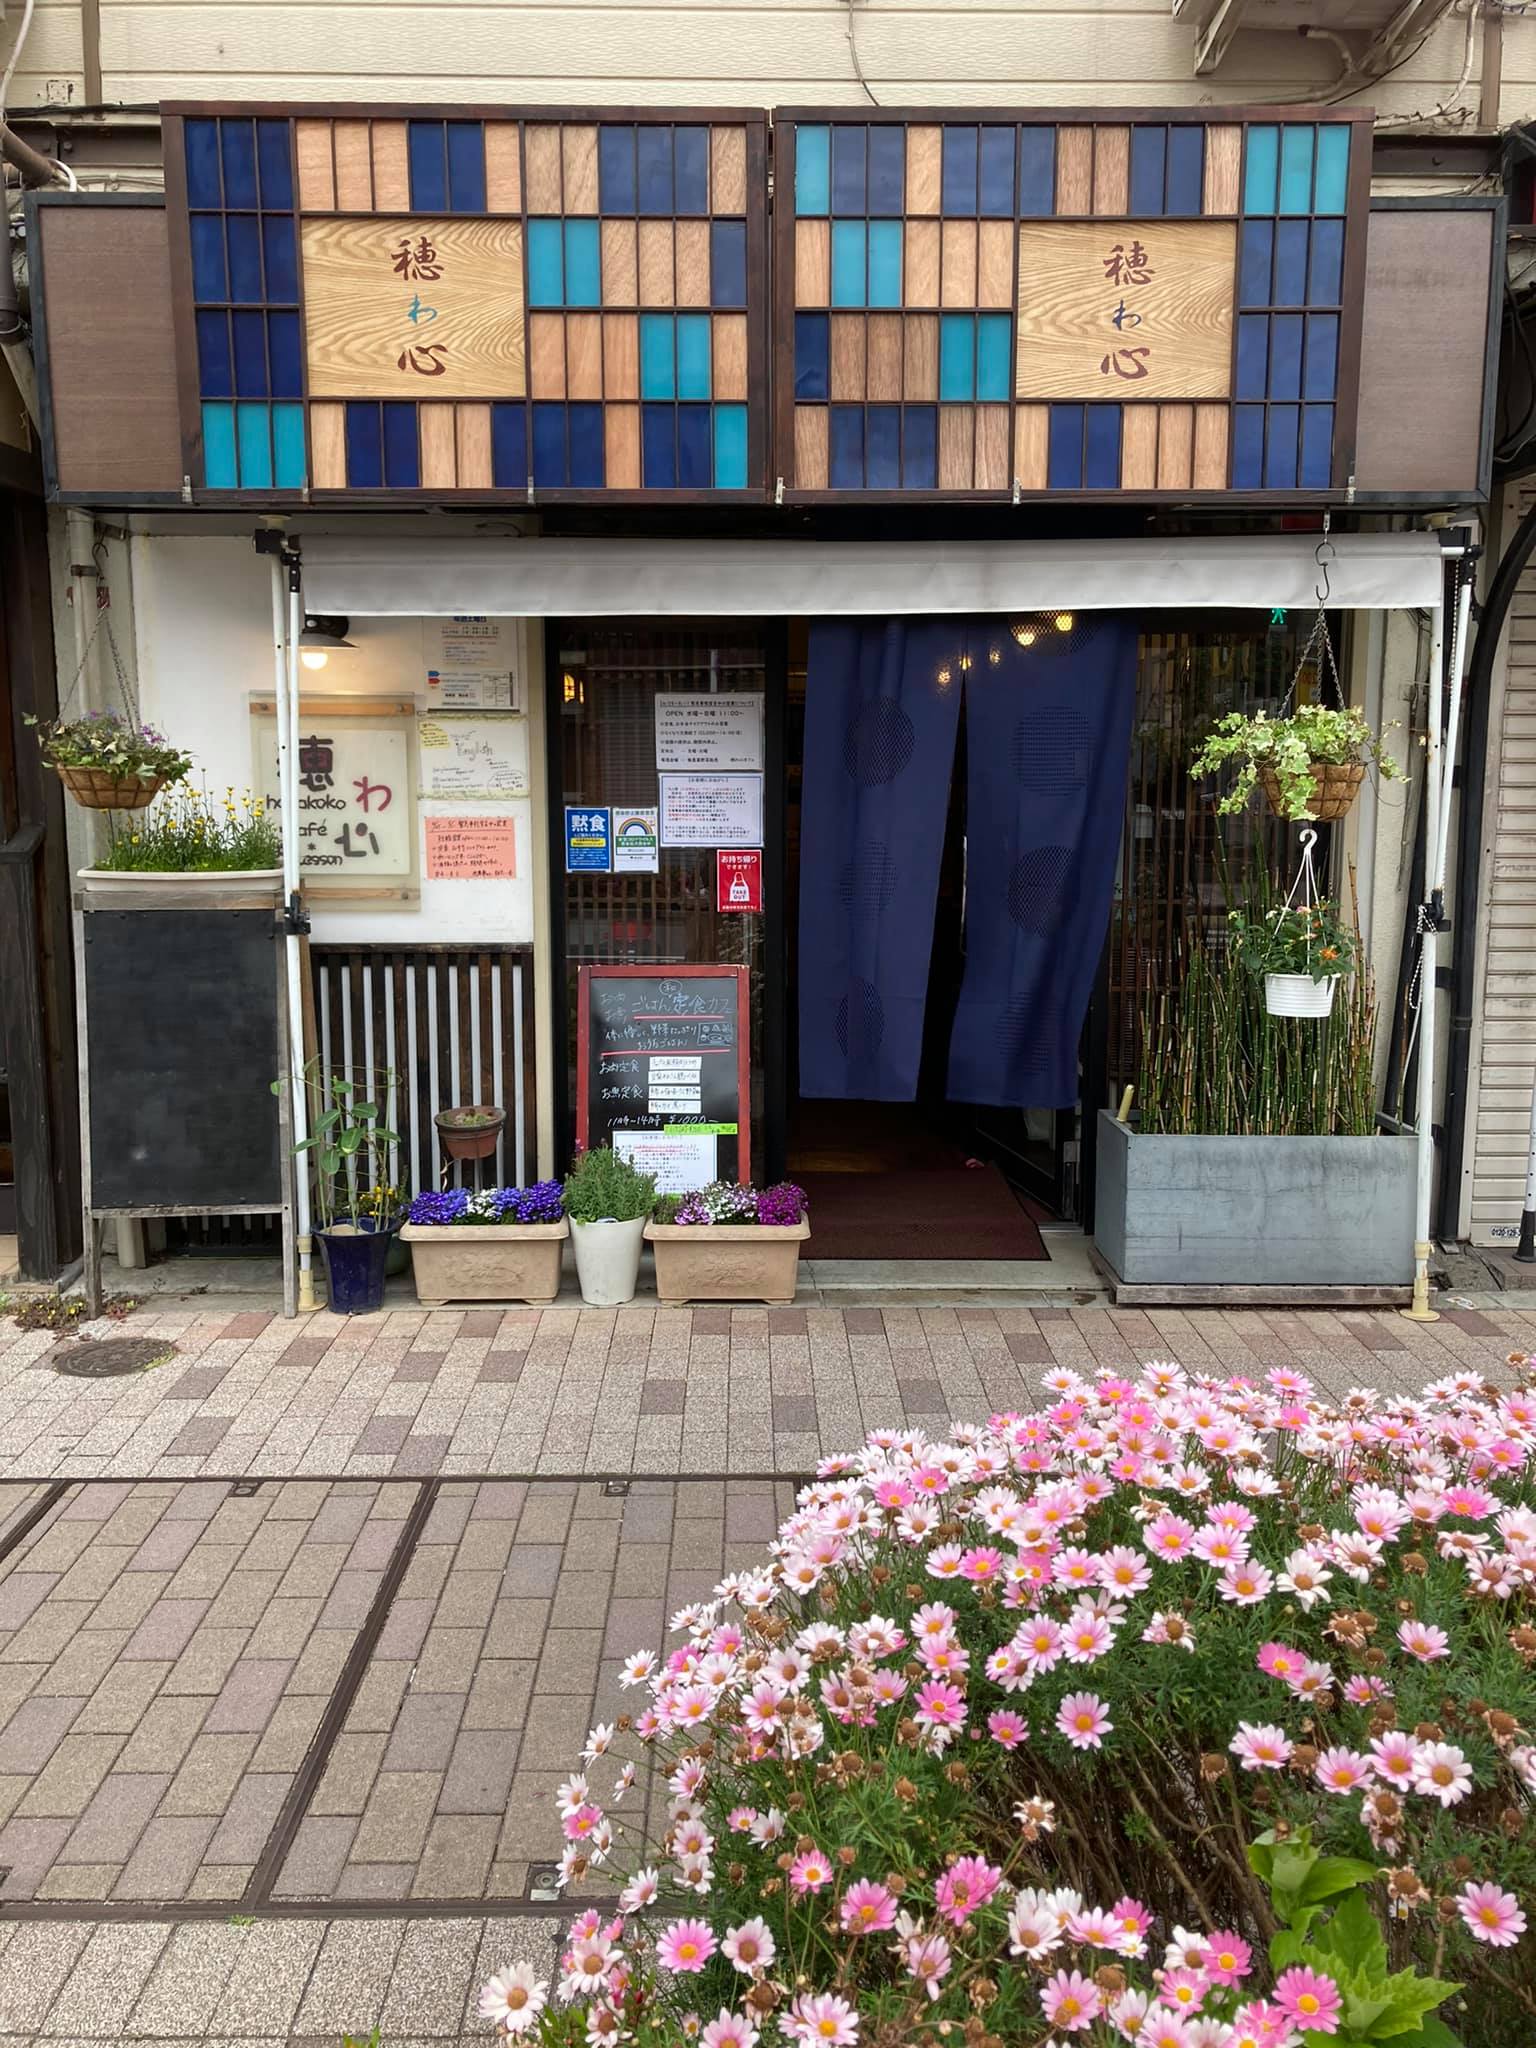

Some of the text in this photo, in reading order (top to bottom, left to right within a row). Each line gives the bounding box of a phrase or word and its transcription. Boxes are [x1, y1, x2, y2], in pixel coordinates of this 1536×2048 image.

[391, 236, 449, 376] 穂わ心
[1100, 240, 1156, 380] 穂わ心
[571, 814, 606, 832] 黙食
